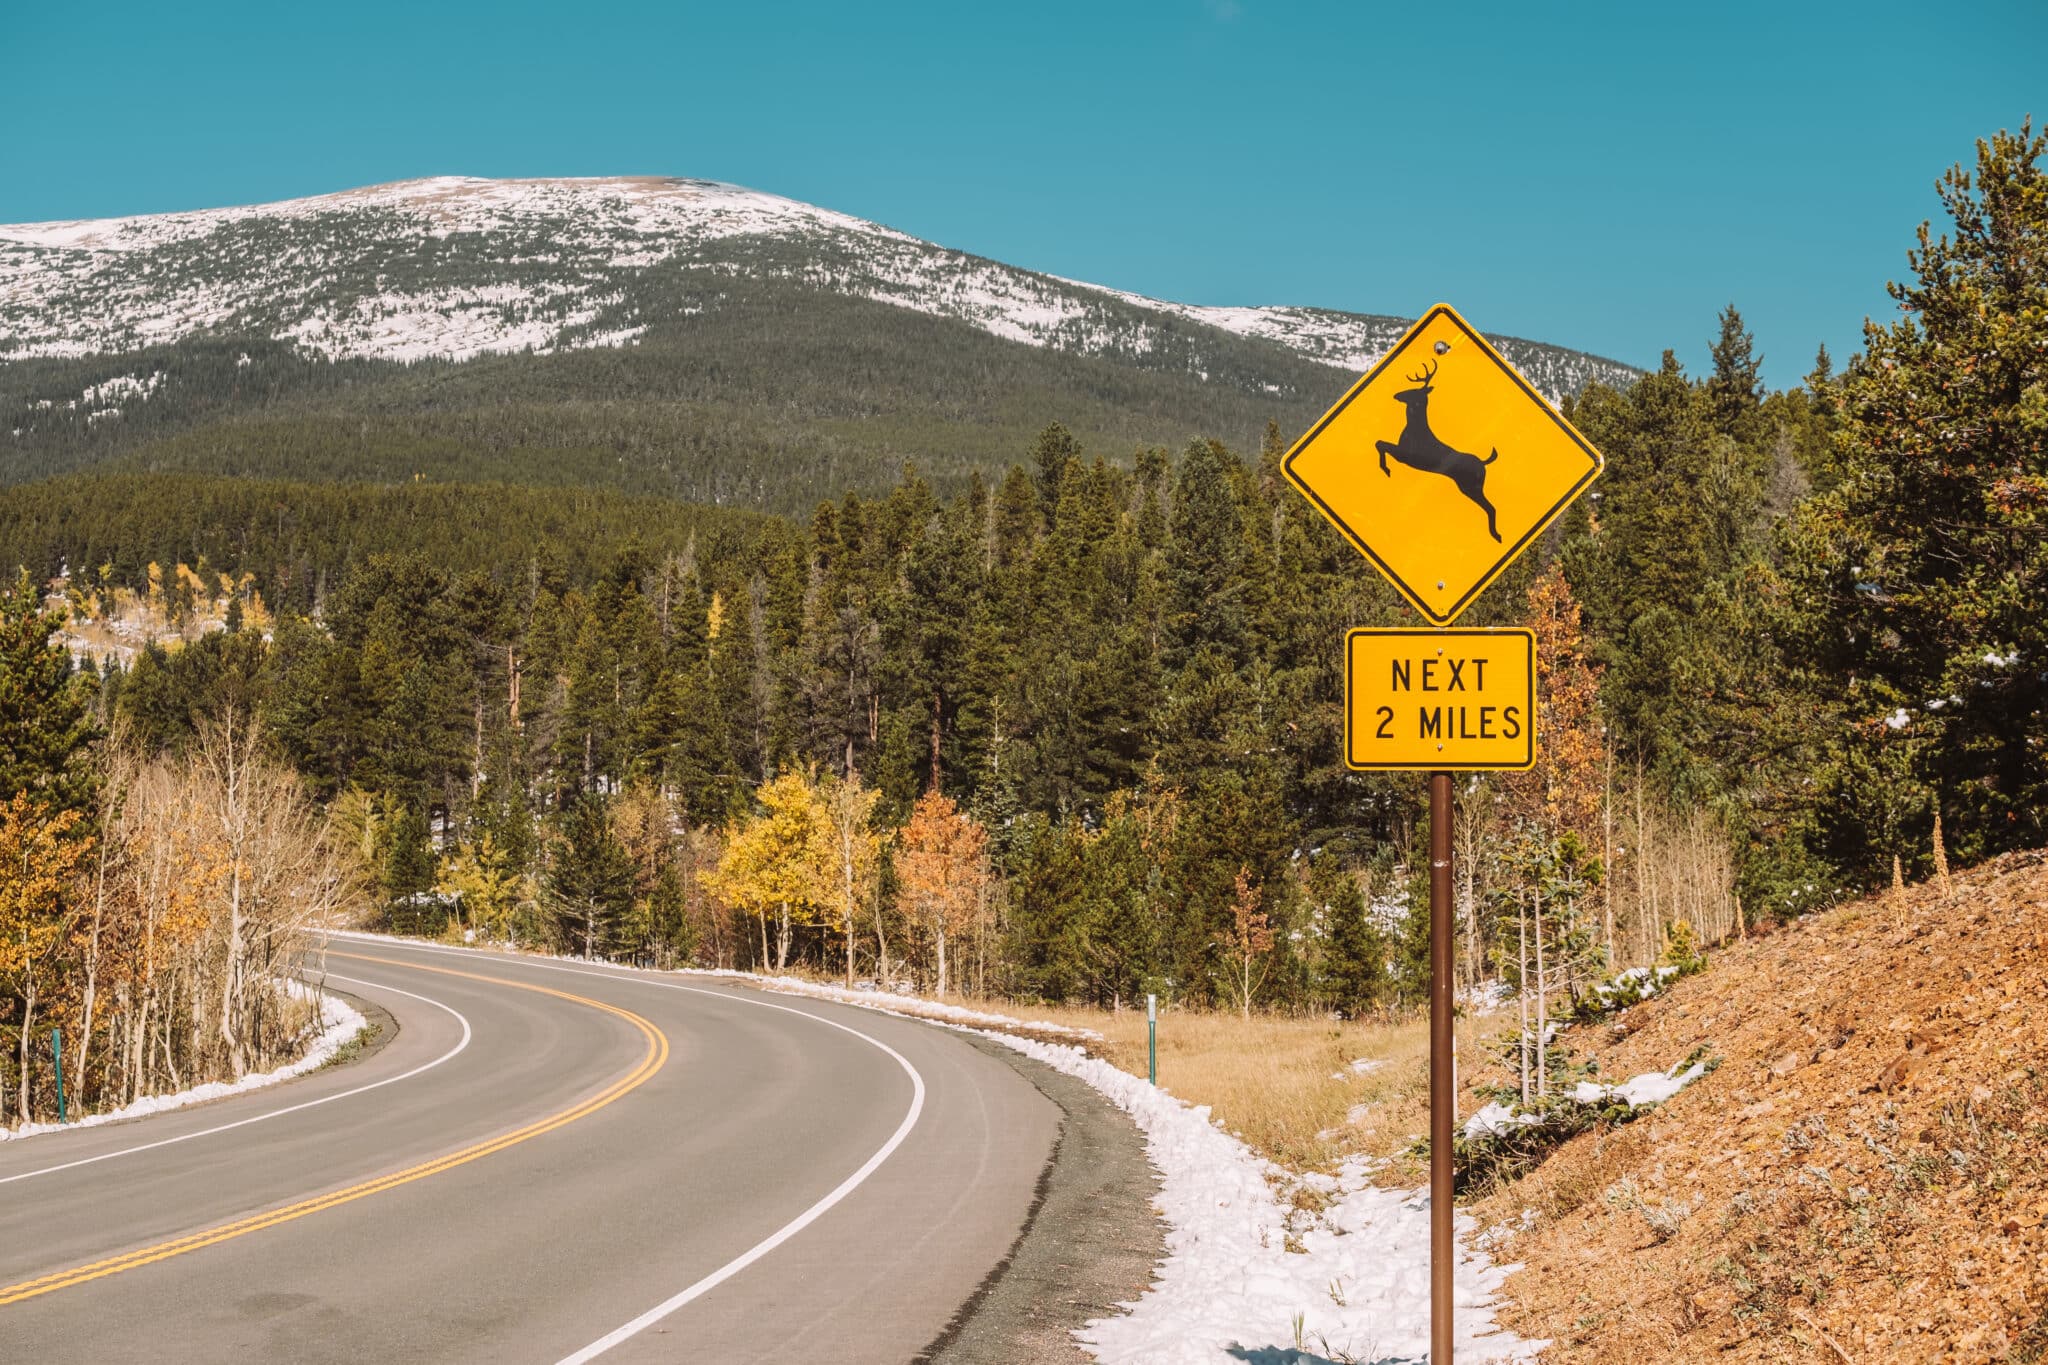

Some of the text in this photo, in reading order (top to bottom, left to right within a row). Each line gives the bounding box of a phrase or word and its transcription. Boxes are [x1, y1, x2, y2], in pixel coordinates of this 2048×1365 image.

[1392, 659, 1488, 691] NEXT
[1376, 706, 1521, 739] 2 MILES
